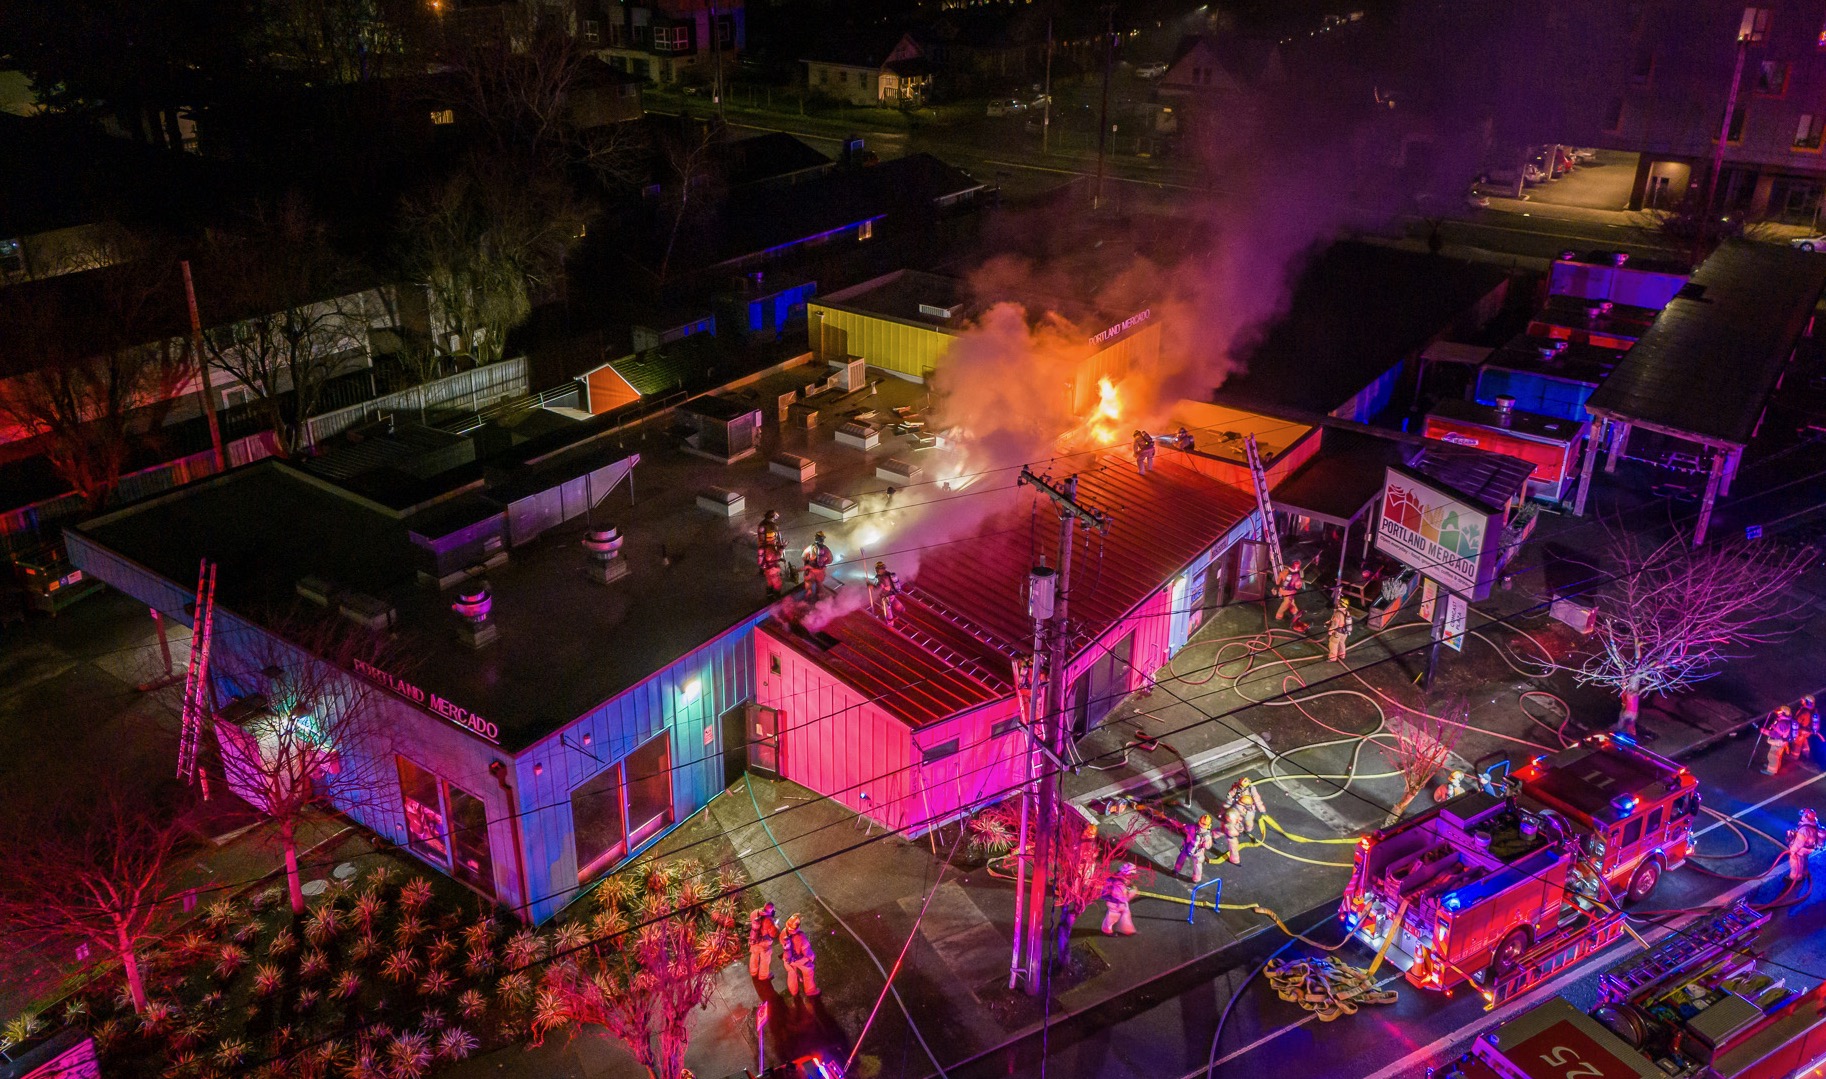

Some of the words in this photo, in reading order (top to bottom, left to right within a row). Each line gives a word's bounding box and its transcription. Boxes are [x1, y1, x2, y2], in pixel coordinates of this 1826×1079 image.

[1088, 324, 1120, 346] PORTLAND
[1122, 309, 1150, 330] MERCADO
[1381, 518, 1426, 551] PORTLAND
[1428, 542, 1475, 578] MERCADO
[353, 658, 425, 702] PORTLAND
[430, 693, 498, 739] MERCADO
